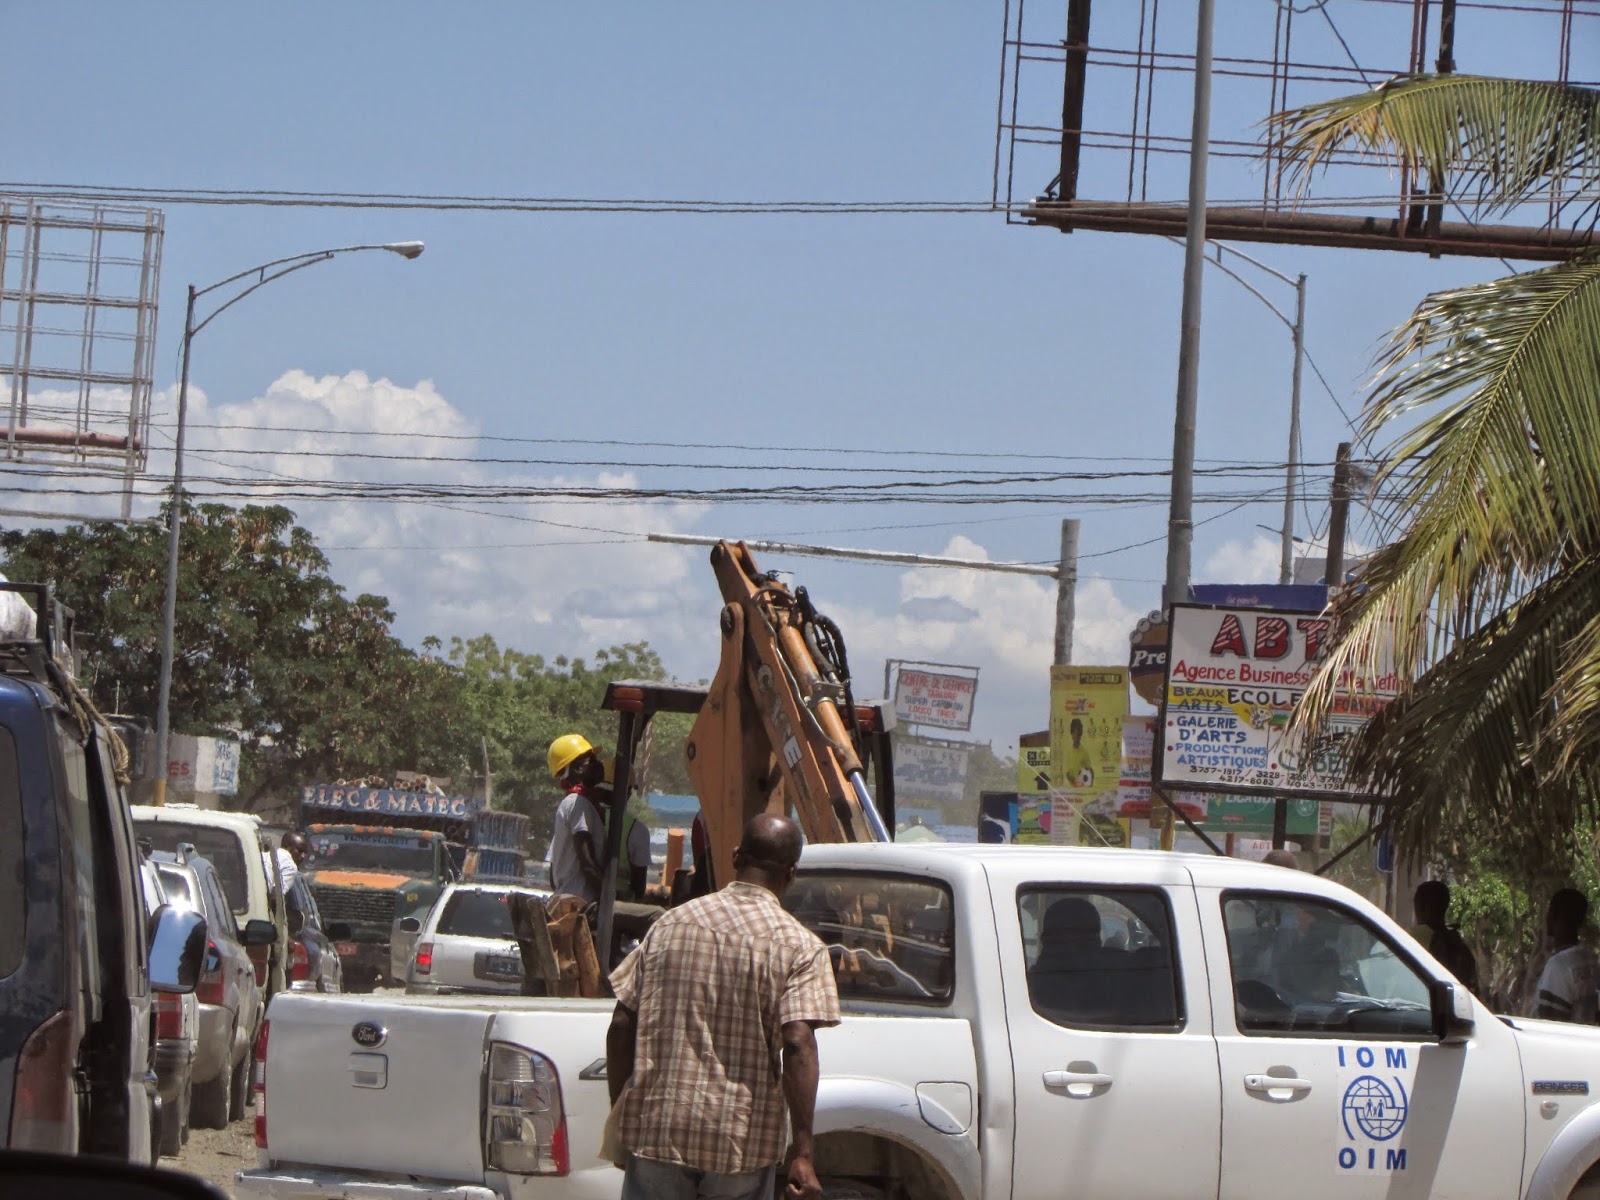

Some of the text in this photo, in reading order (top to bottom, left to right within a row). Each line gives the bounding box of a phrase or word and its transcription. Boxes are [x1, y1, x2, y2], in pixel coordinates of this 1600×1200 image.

[1131, 650, 1167, 667] Pre
[1173, 660, 1235, 682] Agence
[1240, 664, 1309, 687] Business
[1173, 686, 1225, 698] BEAUX
[1227, 688, 1301, 707] ECOLE
[1178, 698, 1223, 711] ARTS
[1176, 715, 1237, 729] GALERIE
[1179, 729, 1247, 743] D'ARTS
[1175, 743, 1267, 756] PRODUCTIONS
[1177, 754, 1267, 769] ARTISTIQUES
[303, 786, 467, 817] ELEC & MATEC
[358, 1026, 376, 1042] Ford
[1337, 1045, 1408, 1069] IOM
[1535, 1082, 1586, 1091] RANGER
[1338, 1147, 1407, 1170] OIM
